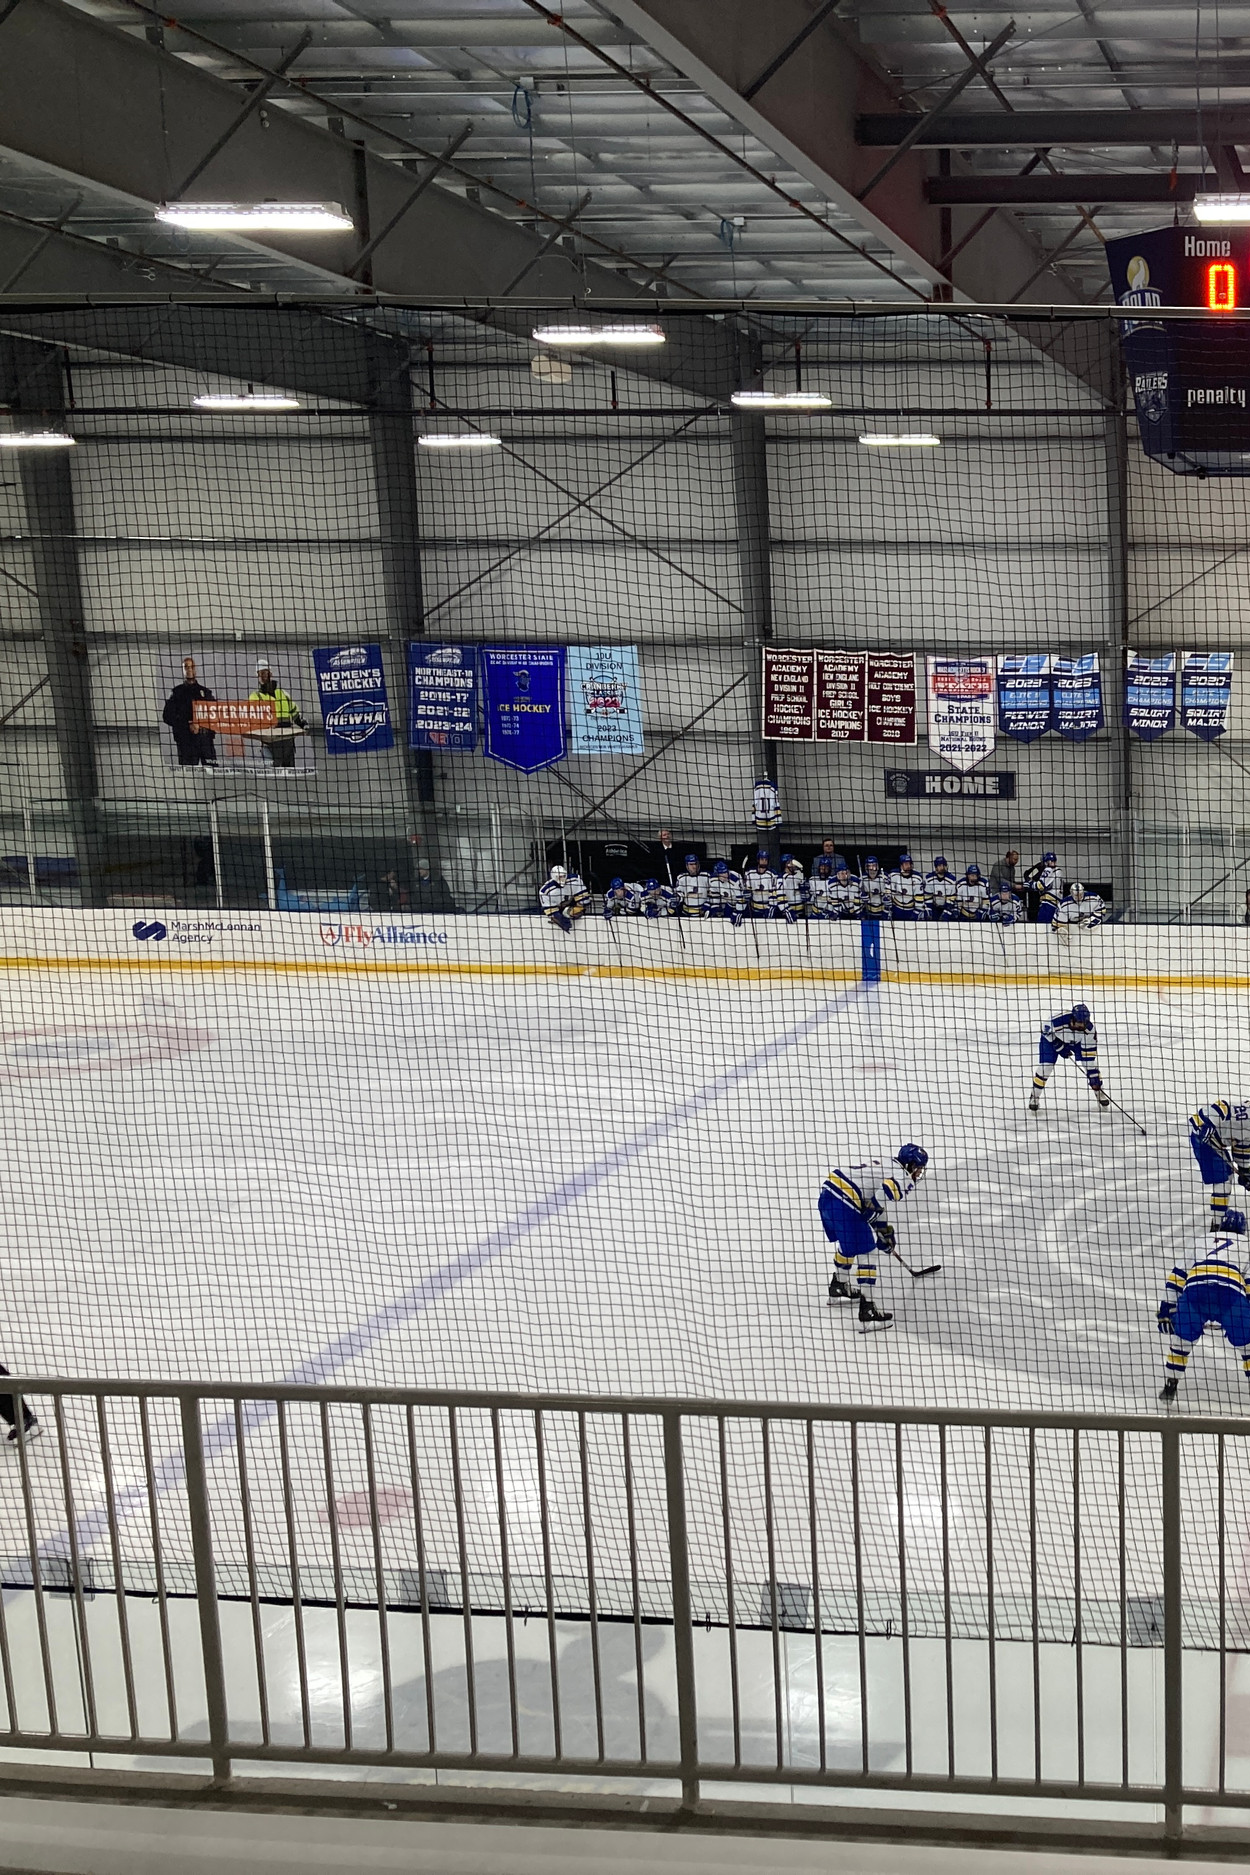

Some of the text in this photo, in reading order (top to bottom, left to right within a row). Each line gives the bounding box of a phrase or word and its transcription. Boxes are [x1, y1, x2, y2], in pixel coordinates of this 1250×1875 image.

[1184, 235, 1231, 257] Home
[1208, 263, 1235, 311] 0
[1135, 375, 1169, 393] RAILERS
[1187, 386, 1247, 408] penalty
[489, 653, 531, 661] WORCESTER
[766, 653, 813, 663] WORCESTER
[818, 654, 865, 664] WORCESTER
[585, 662, 623, 671] DIVISION
[823, 664, 859, 673] ACADEMY
[869, 658, 914, 668] WORCESTER
[319, 668, 381, 681] WOMEN'S
[771, 664, 808, 674] ACADEMY
[873, 670, 909, 680] ACADEMY
[1133, 675, 1169, 686] 2022
[1188, 675, 1227, 686] 2020
[321, 677, 382, 692] ICE HOCKEY
[414, 676, 473, 688] CHAMPIONS
[1005, 678, 1042, 689] 2023
[513, 703, 552, 713] HOCKEY
[773, 703, 806, 714] HOCKEY
[829, 699, 853, 709] GIRLS
[868, 704, 914, 715] ICE HOCKEY
[947, 704, 981, 715] STATE
[417, 705, 471, 718] 2021-22
[818, 709, 864, 720] ICE HOCKEY
[1004, 710, 1050, 720] PEEWEE
[1057, 709, 1099, 720] SQUIRT
[1129, 708, 1172, 718] SQUIRT
[329, 711, 385, 726] NEWHA
[767, 715, 811, 726] CHAMPIONS
[934, 713, 992, 724] CHAMPIONS
[1131, 719, 1168, 728] MINOR
[415, 719, 473, 732] 2023-24
[596, 724, 617, 733] 2023
[819, 719, 863, 730] CHAMPIONS
[1008, 721, 1046, 731] MINOR
[1059, 720, 1099, 731] MAJOR
[582, 734, 635, 743] CHAMPIONS
[831, 730, 850, 738] 2017
[939, 743, 987, 752] 2021-2022
[925, 775, 1000, 795] HOME
[171, 932, 213, 944] Agency
[344, 924, 448, 948] FlyAlliance
[1206, 1237, 1234, 1257] 7
